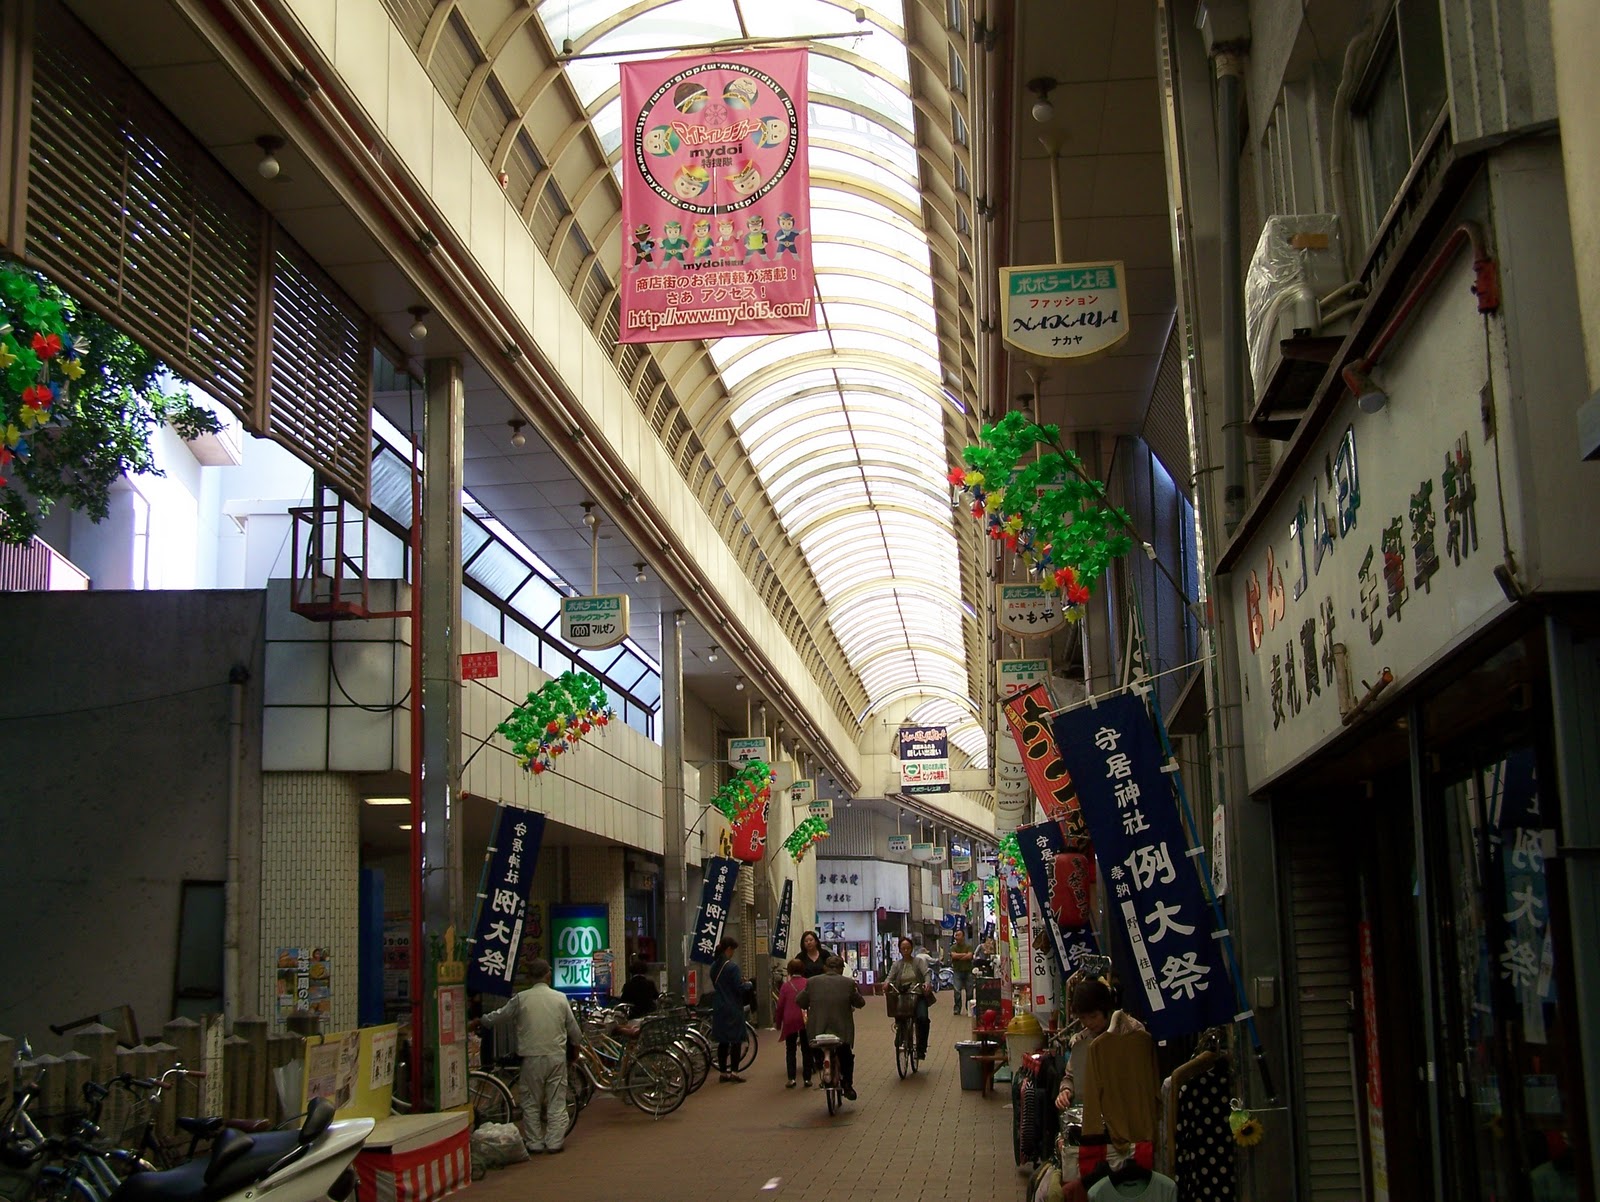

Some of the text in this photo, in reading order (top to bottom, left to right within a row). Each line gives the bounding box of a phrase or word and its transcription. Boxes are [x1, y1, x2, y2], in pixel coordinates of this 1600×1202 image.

[690, 143, 743, 159] mydoi
[1016, 269, 1111, 294] ポポラーレ土居
[666, 291, 694, 305] さあ
[1029, 295, 1099, 309] ファッション
[628, 299, 811, 331] http://www.mydoi5.com/
[1051, 335, 1083, 346] ナカヤ
[1005, 588, 1057, 599] ポポラーレ
[1009, 611, 1054, 624] いもや
[592, 623, 616, 634] マルゼン
[1094, 726, 1151, 836] 守居神社
[1110, 865, 1133, 898] 奉納
[1124, 841, 1211, 1000] 例大祭
[559, 964, 592, 985] マルゼ
